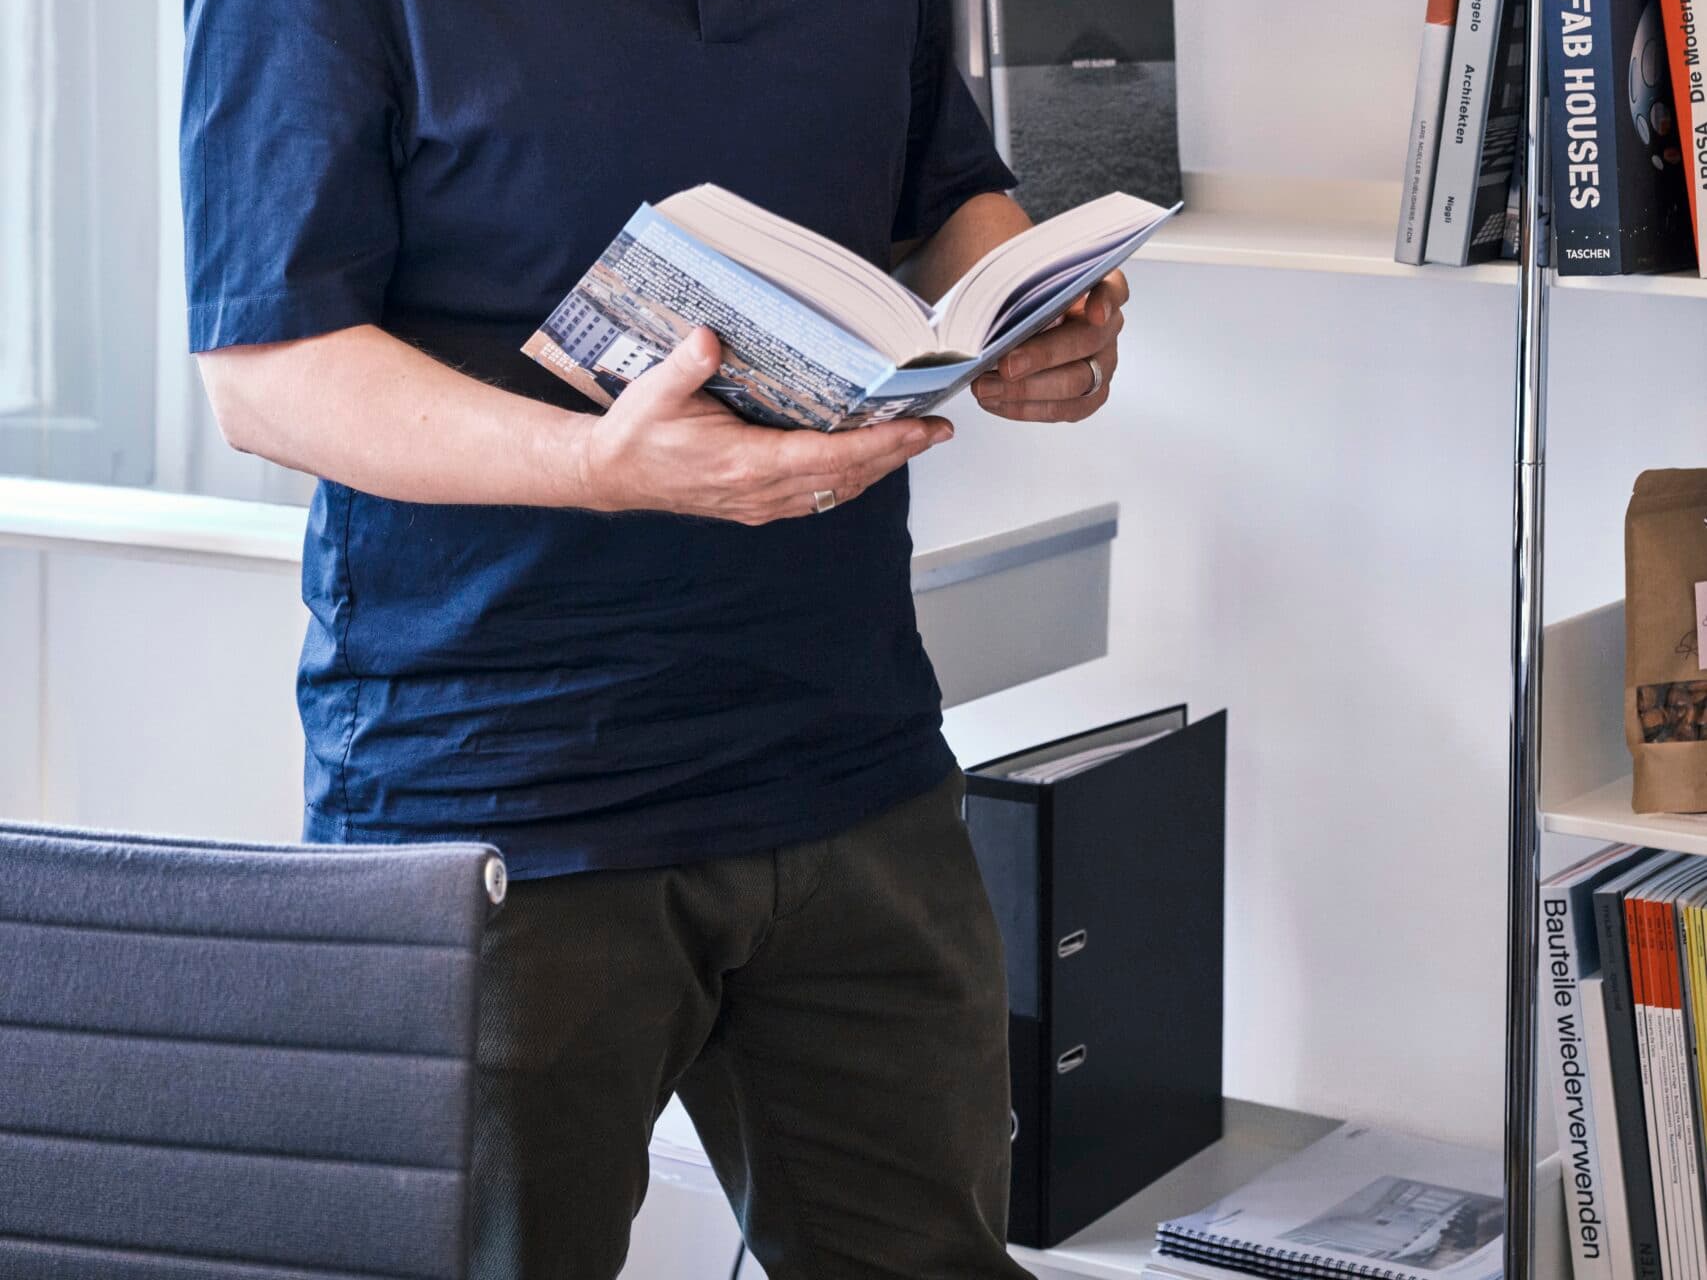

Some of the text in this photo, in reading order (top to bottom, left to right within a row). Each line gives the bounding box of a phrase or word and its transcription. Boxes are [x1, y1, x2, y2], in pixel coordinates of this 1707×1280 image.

[1454, 64, 1476, 146] Architekten
[1689, 71, 1706, 103] Die
[1563, 67, 1601, 210] HOUSES
[1444, 195, 1455, 225] Niggli
[1566, 247, 1611, 260] TASCHEN
[1544, 898, 1601, 1260] Bauteile wiederverwenden
